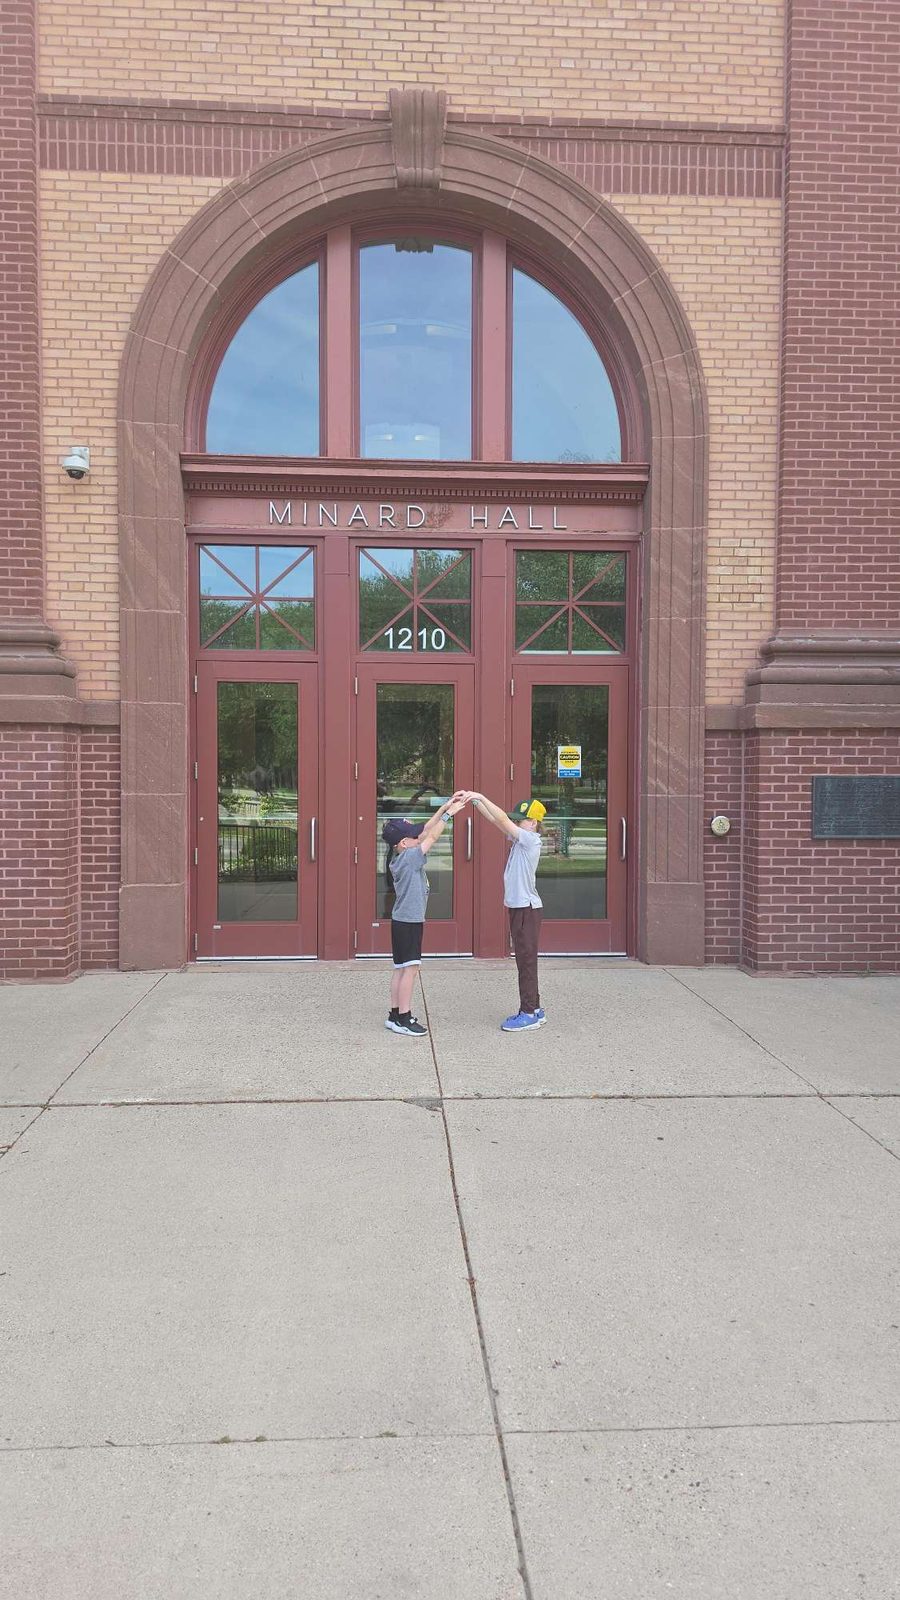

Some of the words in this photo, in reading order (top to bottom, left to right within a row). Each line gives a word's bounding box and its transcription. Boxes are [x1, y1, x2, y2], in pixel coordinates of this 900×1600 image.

[269, 501, 426, 528] MINARD
[471, 505, 567, 529] HALL
[384, 627, 446, 650] 1210
